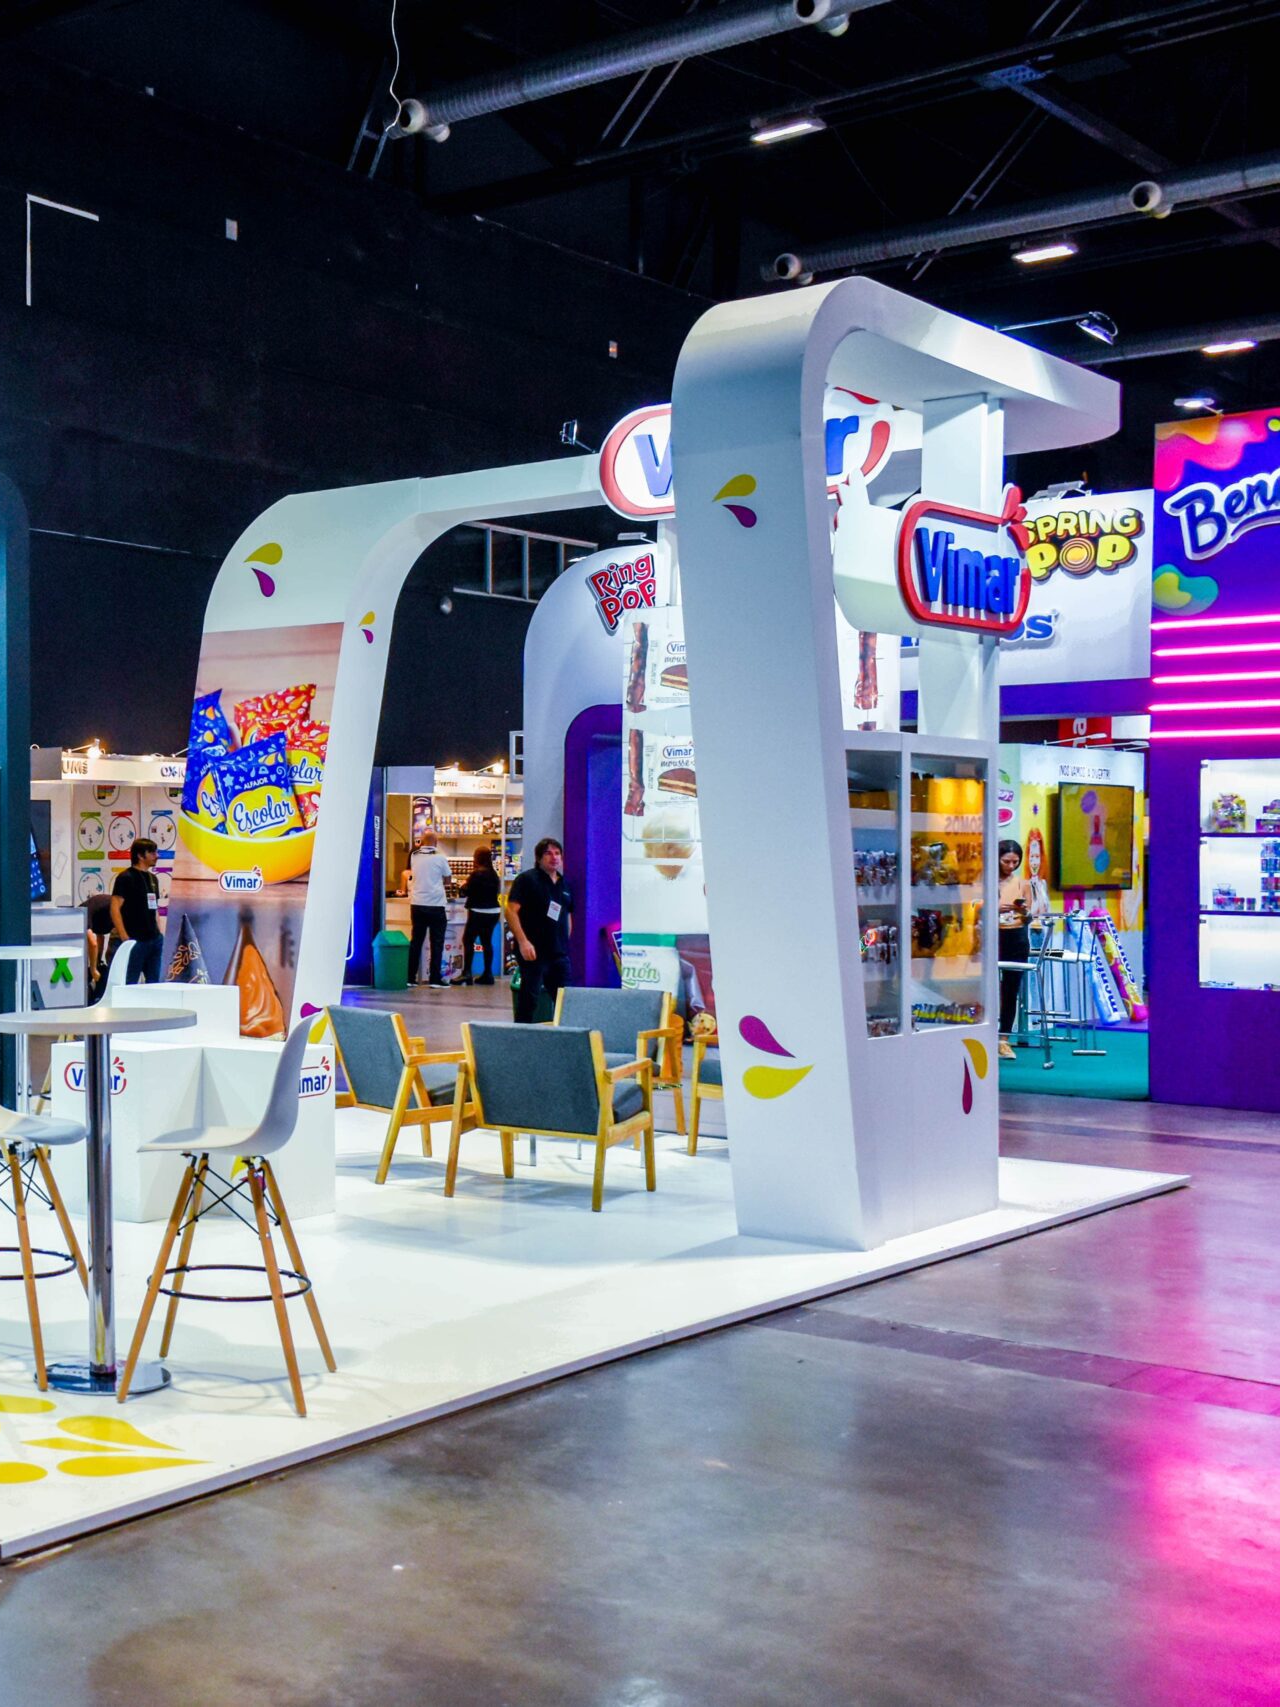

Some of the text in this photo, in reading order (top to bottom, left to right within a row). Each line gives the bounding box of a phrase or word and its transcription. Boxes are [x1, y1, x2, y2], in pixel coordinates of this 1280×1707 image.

[1022, 508, 1139, 544] SPRING
[916, 526, 1020, 615] Vimar
[1025, 534, 1132, 579] POP
[590, 554, 654, 598] Ring
[666, 747, 692, 757] Vimar
[243, 776, 269, 790] ALFAJOR
[233, 795, 295, 832] Escolar
[224, 876, 259, 890] Vimar
